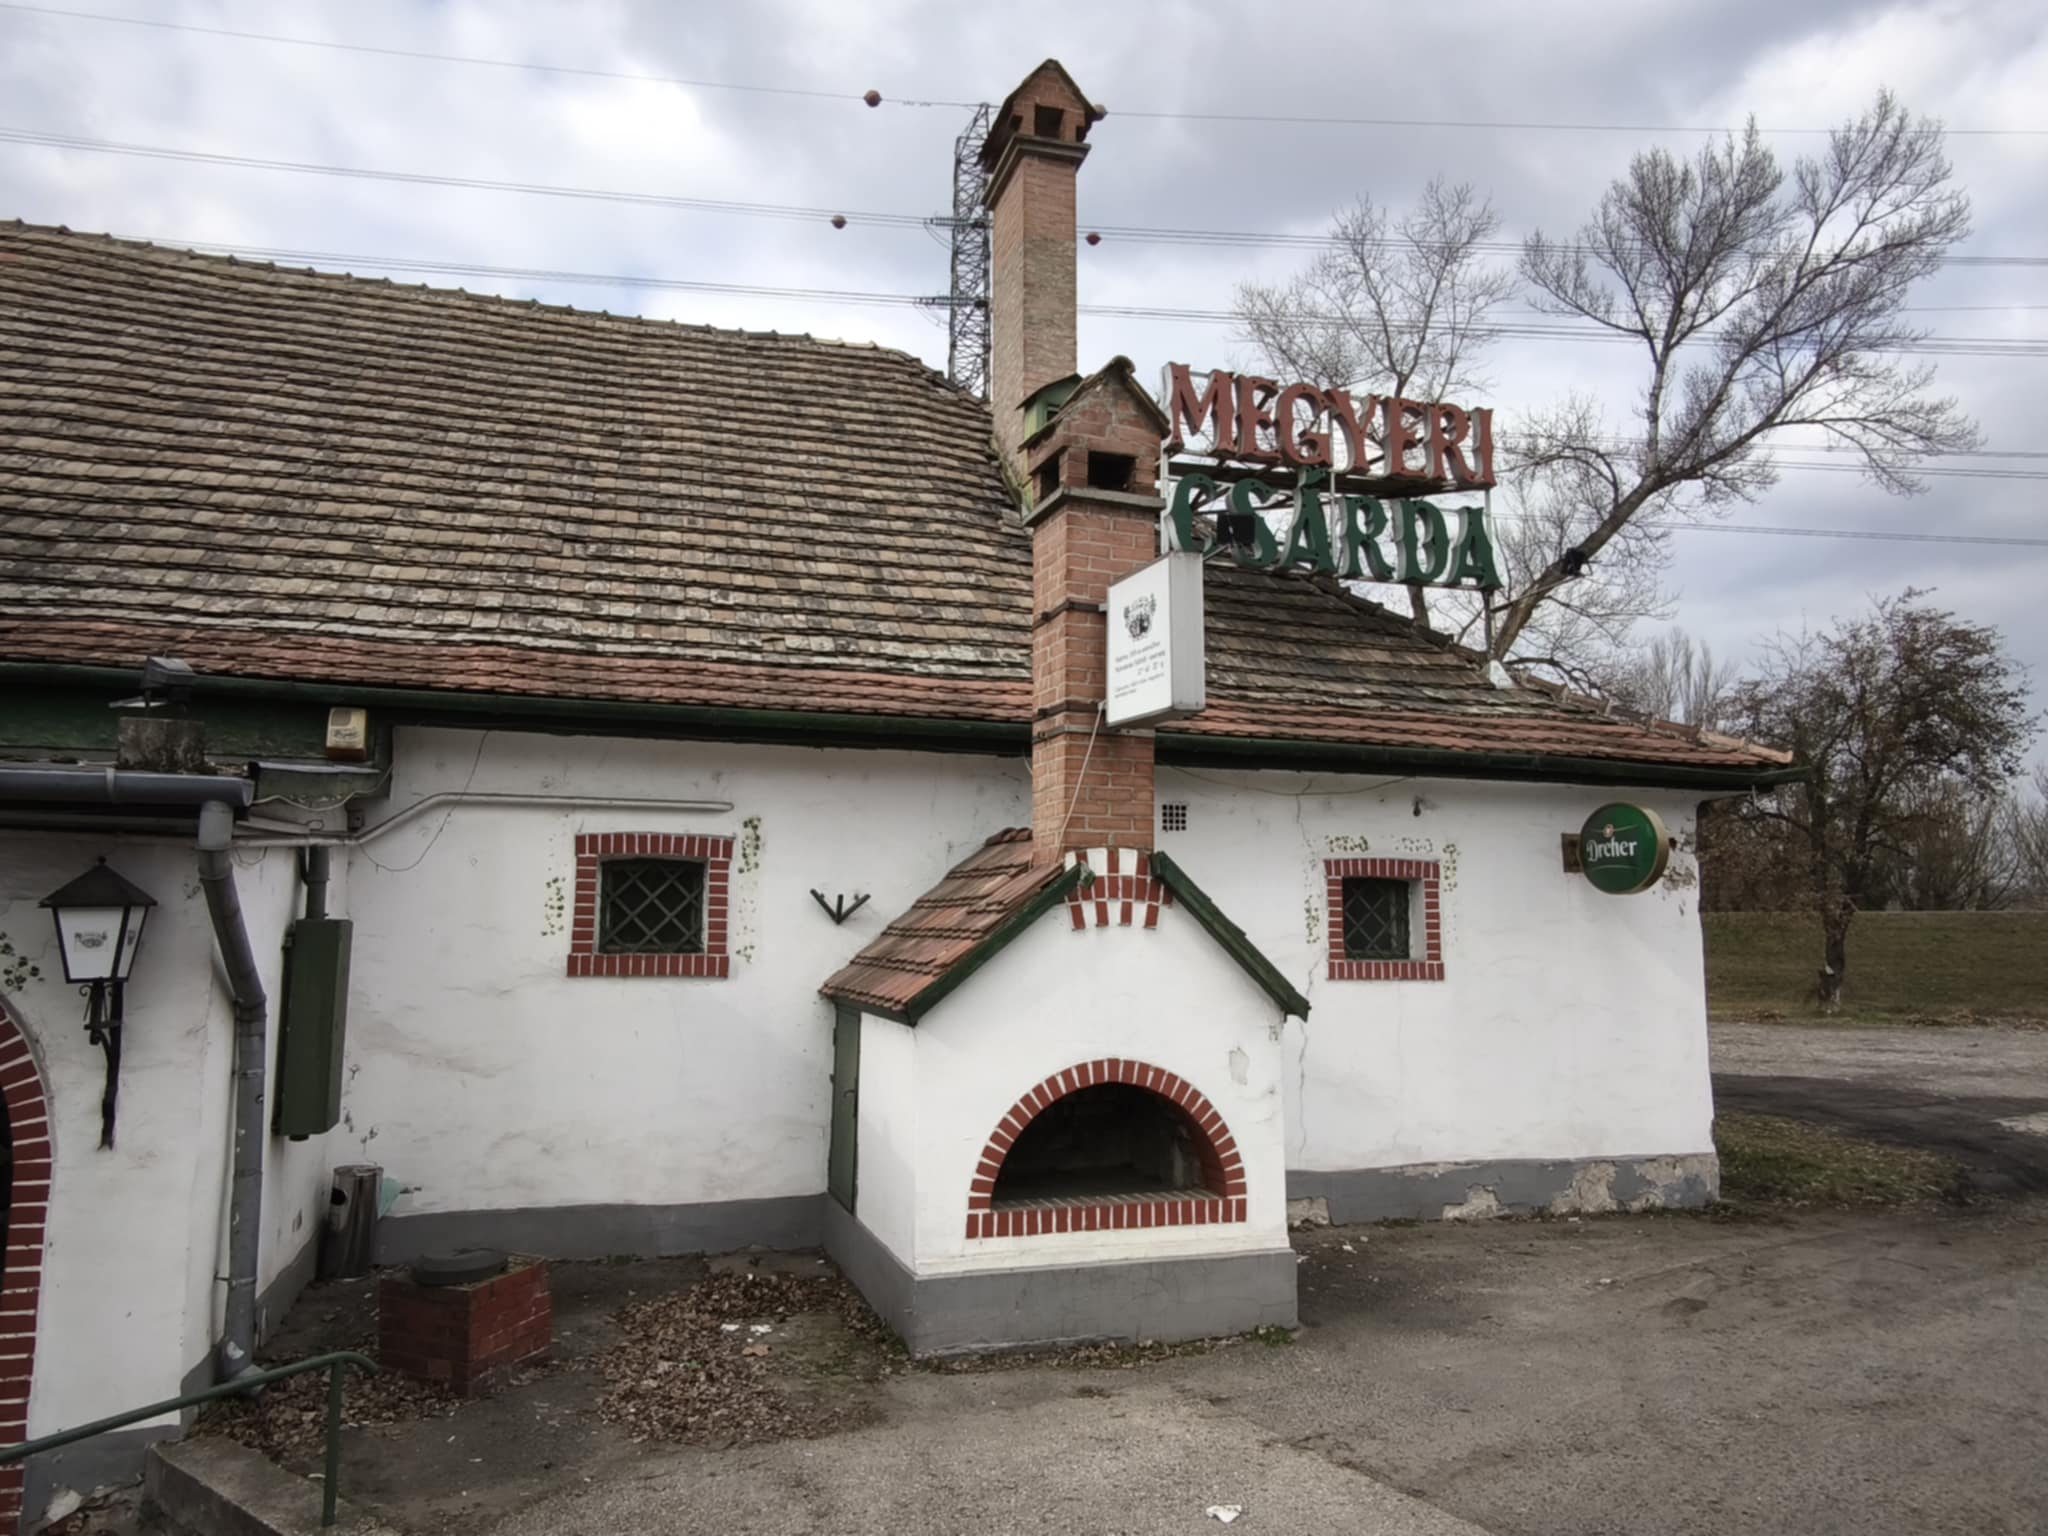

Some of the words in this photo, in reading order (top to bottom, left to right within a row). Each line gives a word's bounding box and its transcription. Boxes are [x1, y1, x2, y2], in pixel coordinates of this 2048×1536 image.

[1163, 362, 1496, 487] MEGYERI
[1165, 465, 1503, 588] CSÁRDA
[1586, 836, 1637, 862] Dreher
